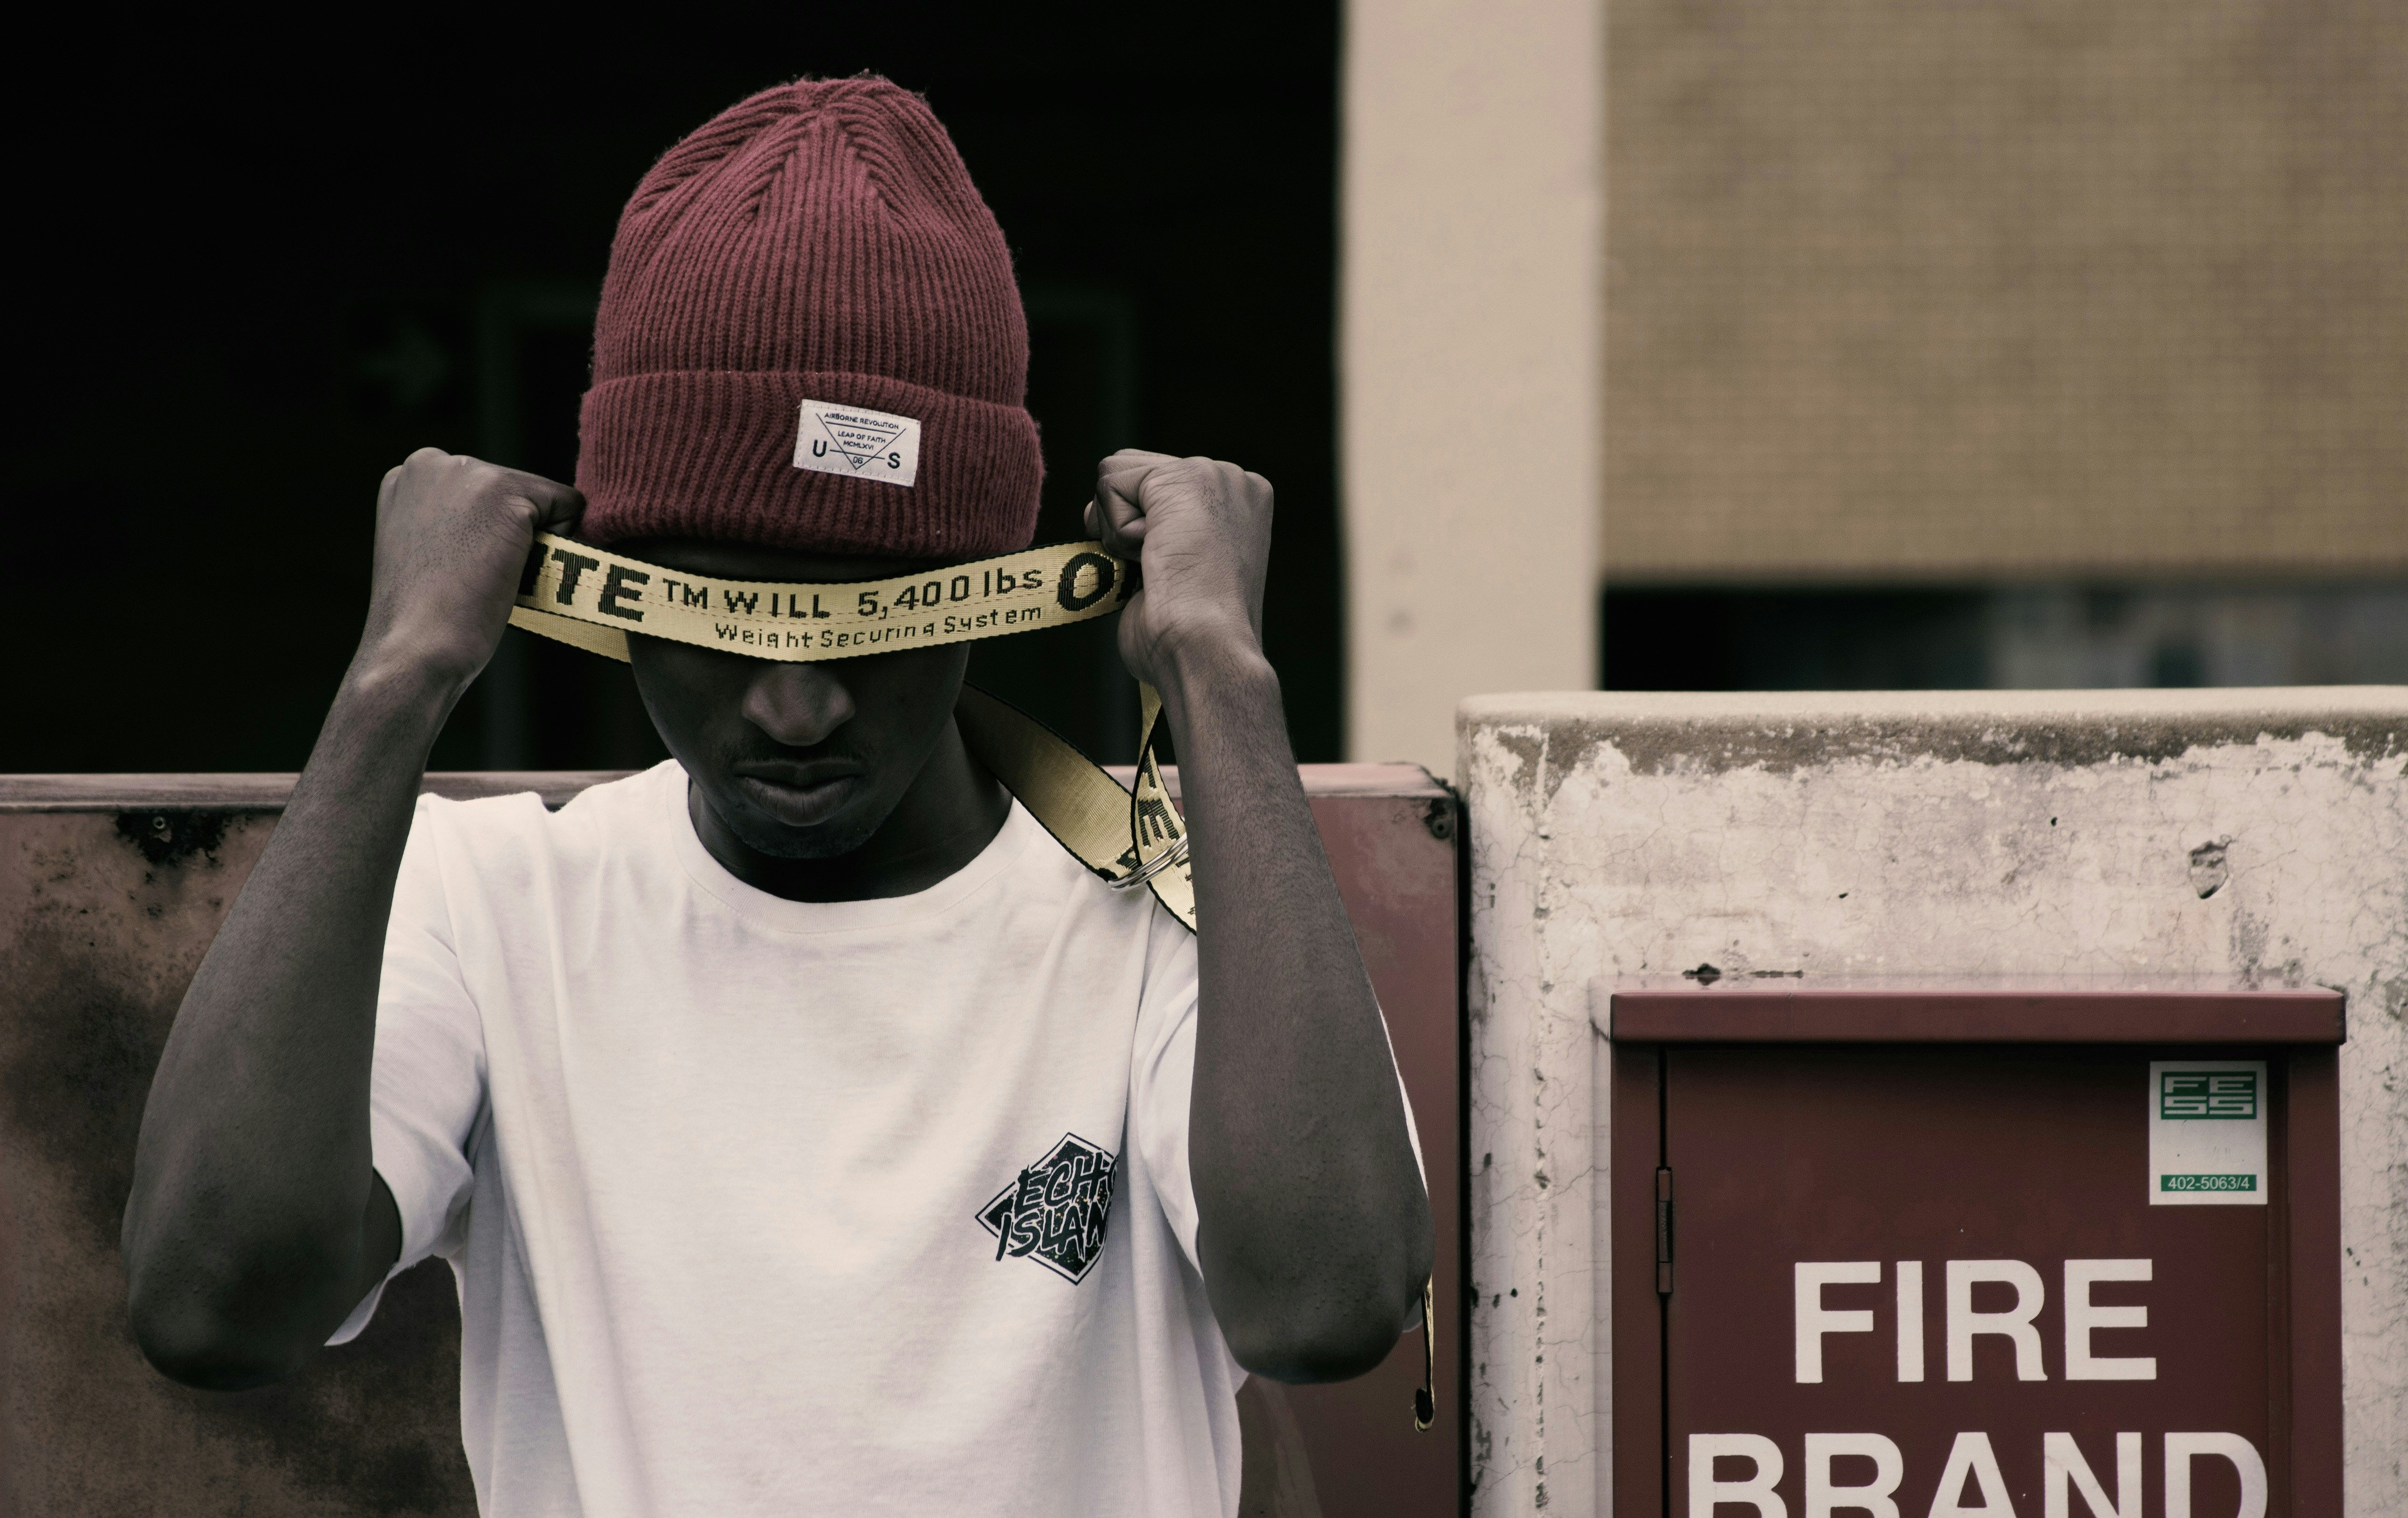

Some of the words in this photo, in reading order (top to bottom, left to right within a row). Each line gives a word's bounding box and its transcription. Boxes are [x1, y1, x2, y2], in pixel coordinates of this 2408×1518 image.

[824, 413, 858, 423] AIRBORNE
[860, 418, 899, 429] REVOLUTION
[813, 439, 827, 457] U
[887, 452, 901, 469] S
[843, 440, 874, 450] MCMLXVI
[858, 575, 970, 620] 5,400
[984, 568, 1043, 597] lbs
[715, 623, 813, 649] Weight
[821, 622, 935, 648] Securing
[944, 607, 1041, 634] System
[2168, 1176, 2250, 1190] 402-5063/4
[1795, 1259, 2157, 1383] FIRE
[1688, 1432, 2268, 1518] BRAND
